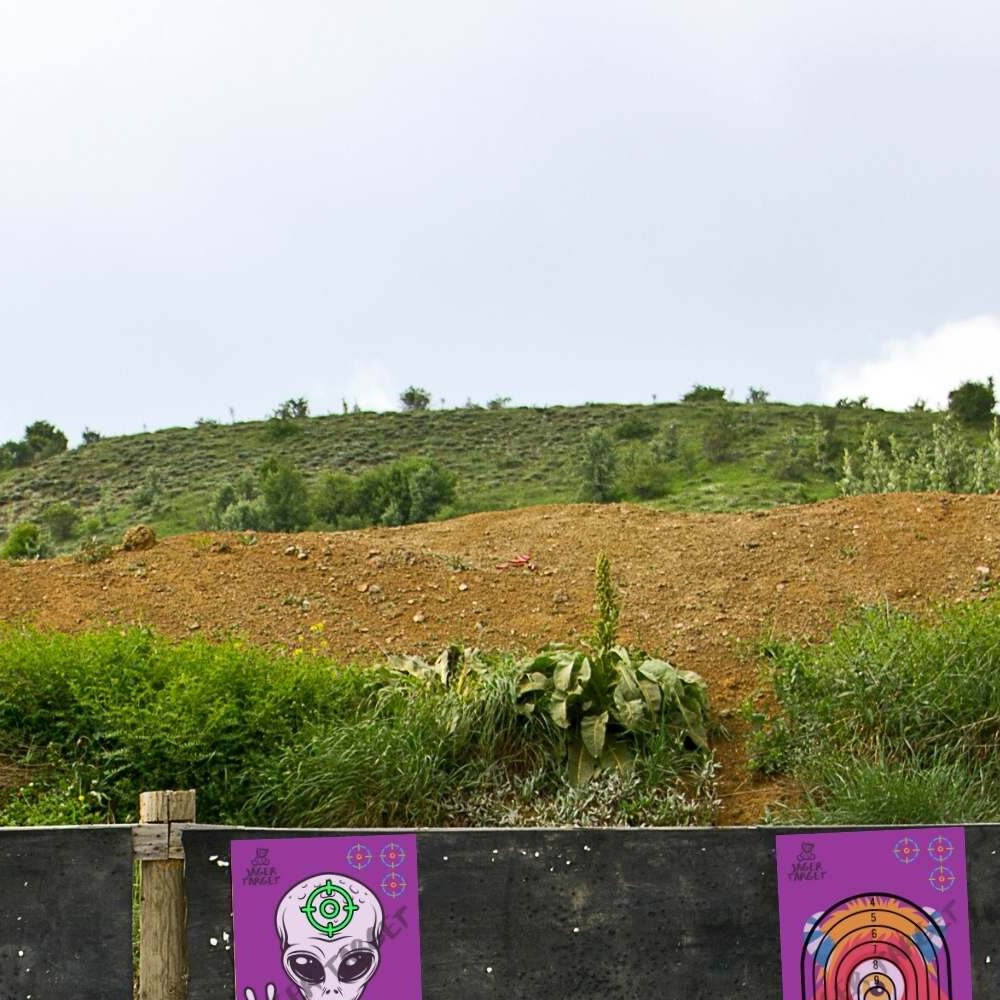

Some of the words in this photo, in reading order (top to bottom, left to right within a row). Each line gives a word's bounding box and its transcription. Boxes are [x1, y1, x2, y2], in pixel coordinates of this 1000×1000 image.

[870, 897, 875, 907] 4
[870, 912, 877, 922] 5
[871, 928, 878, 939] 6
[872, 944, 877, 954] 7
[872, 960, 879, 970] 8
[873, 975, 880, 985] 9
